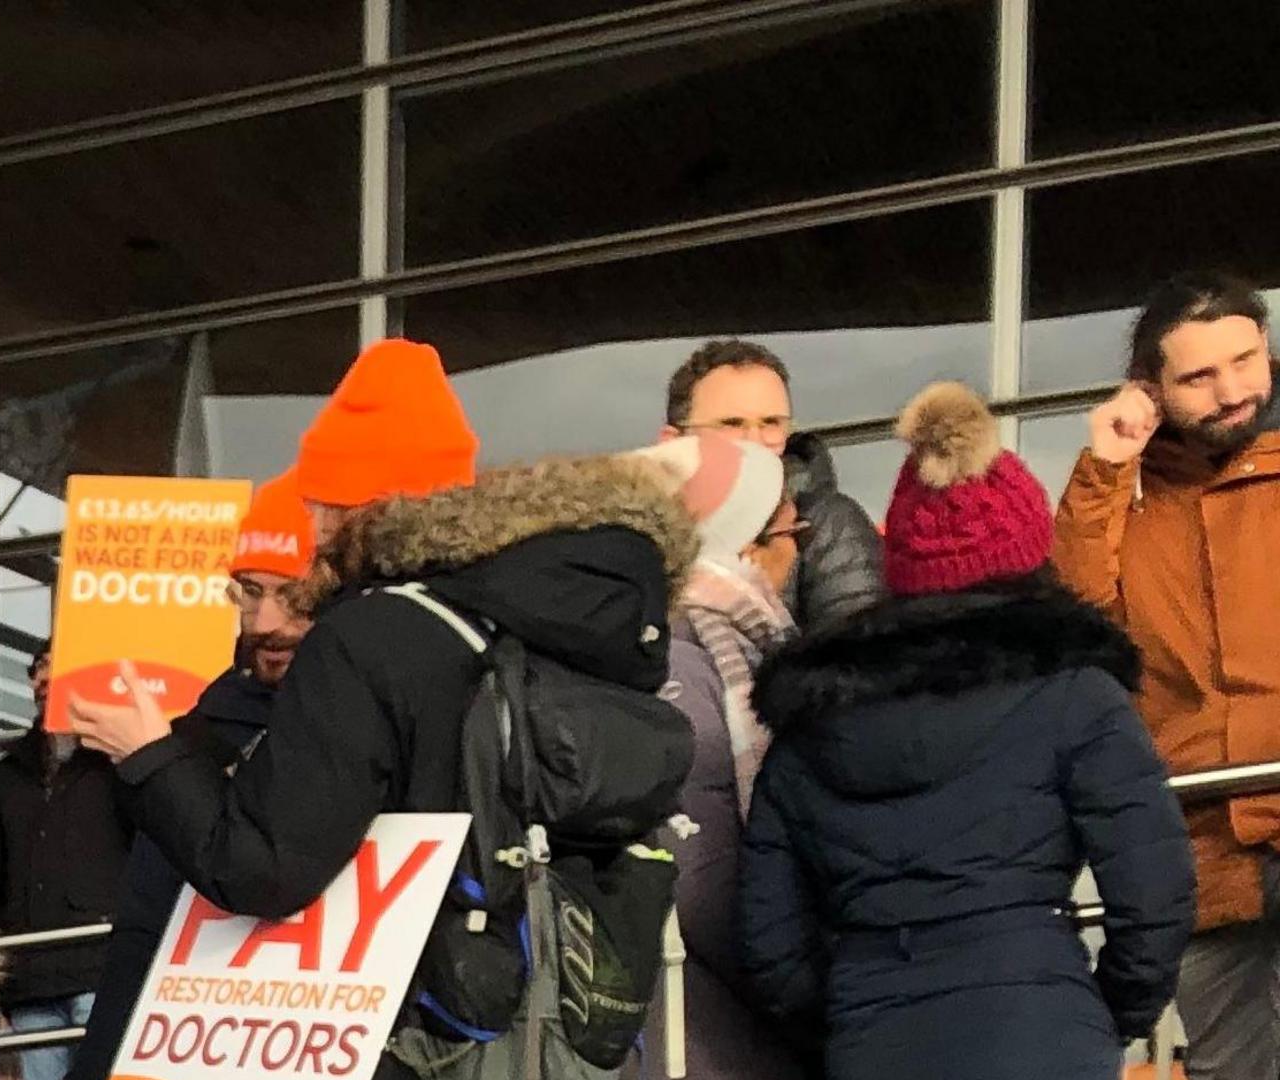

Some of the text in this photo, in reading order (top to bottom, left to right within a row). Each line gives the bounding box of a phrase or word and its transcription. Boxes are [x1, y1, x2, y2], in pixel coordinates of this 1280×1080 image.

[77, 525, 234, 546] IS NOT A FAIR
[74, 548, 143, 569] WAGE
[155, 550, 207, 570] FOR
[155, 976, 386, 1013] RESTORATION FOR
[133, 1013, 370, 1077] DOCTORS
